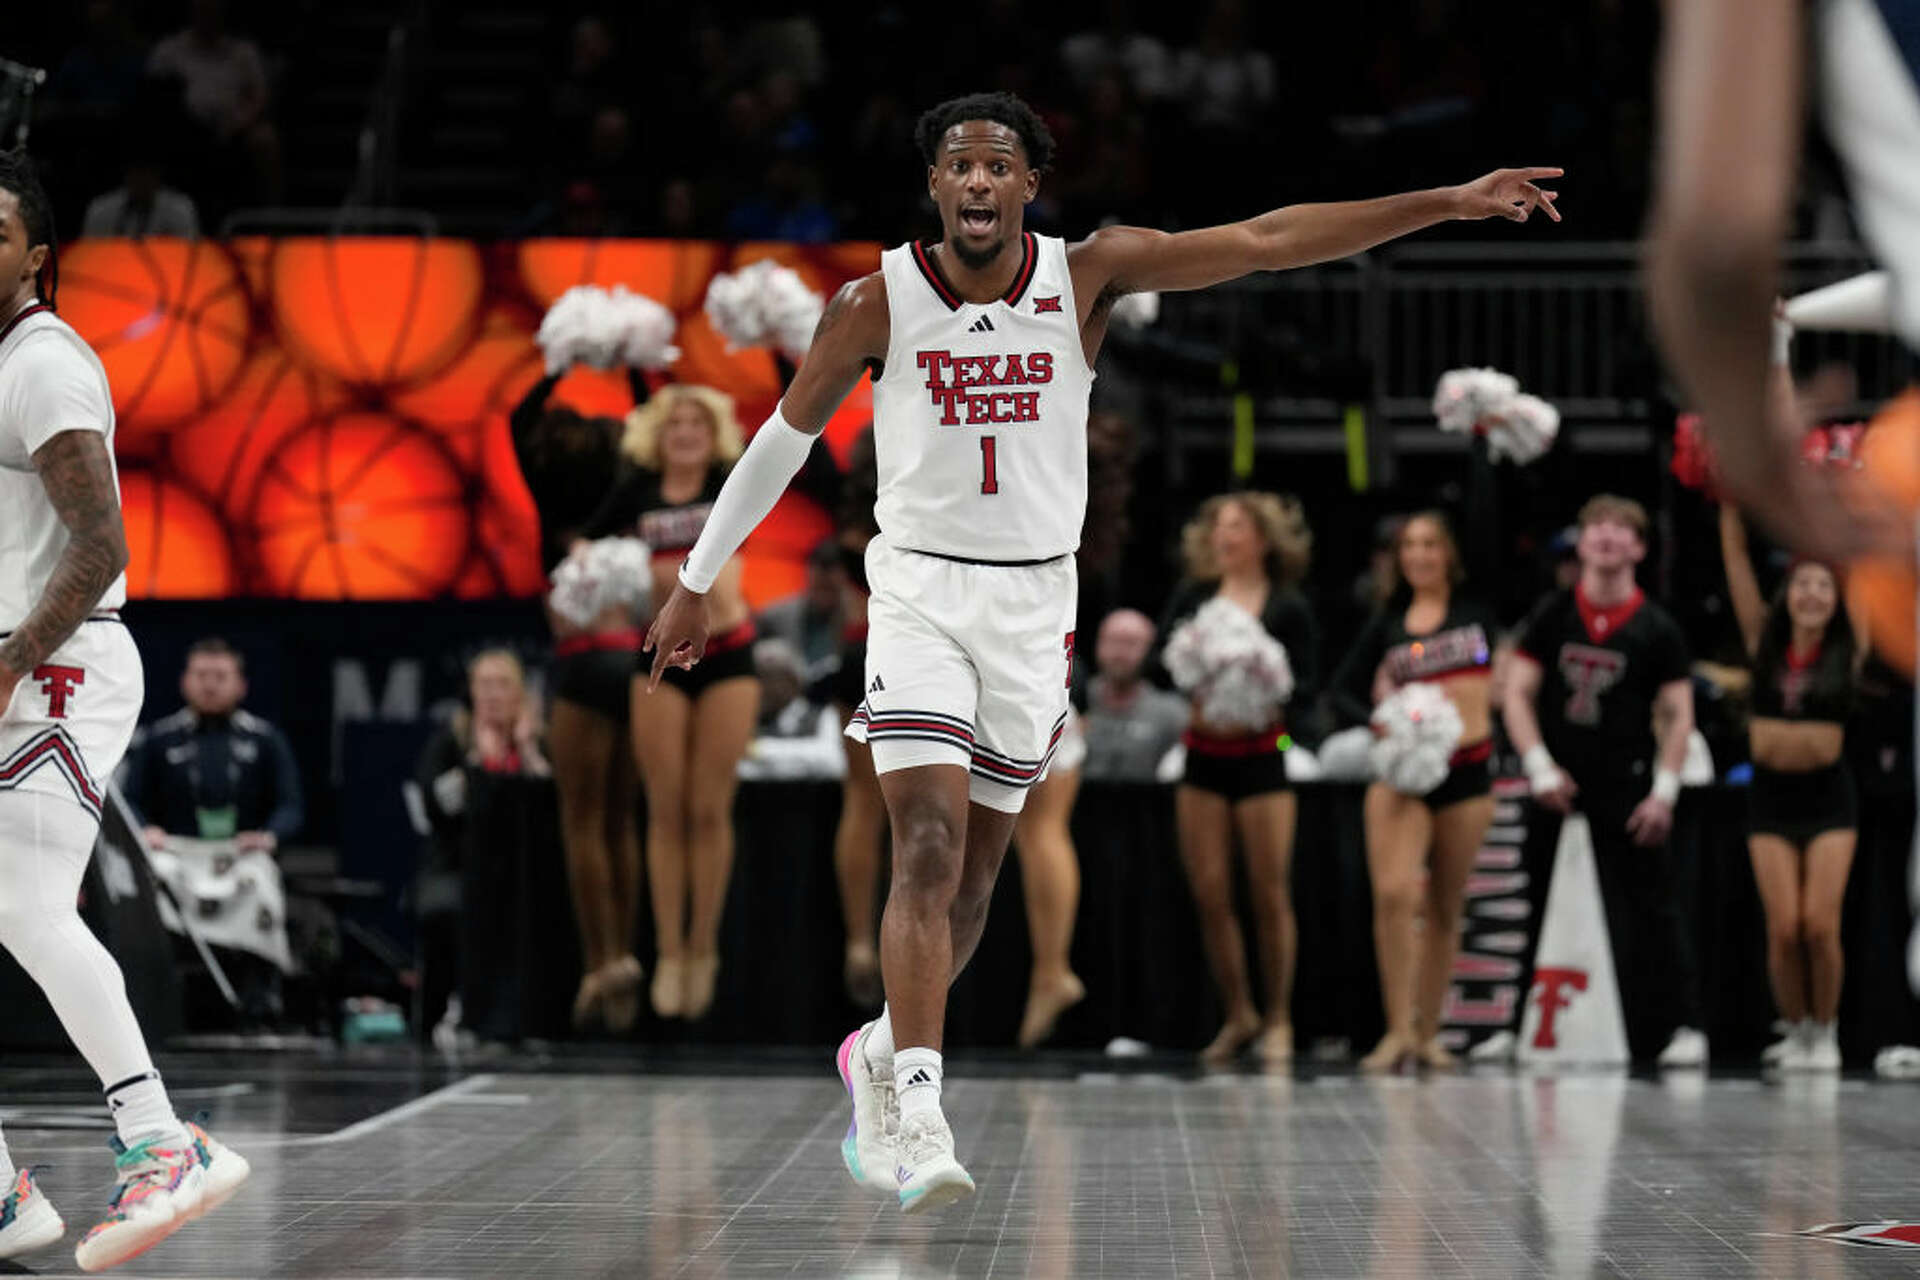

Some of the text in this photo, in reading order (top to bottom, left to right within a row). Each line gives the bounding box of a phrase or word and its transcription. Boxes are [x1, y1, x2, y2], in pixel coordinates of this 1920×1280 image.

[917, 350, 1054, 389] TEXAS
[931, 386, 1040, 426] TECH
[980, 436, 998, 494] 1
